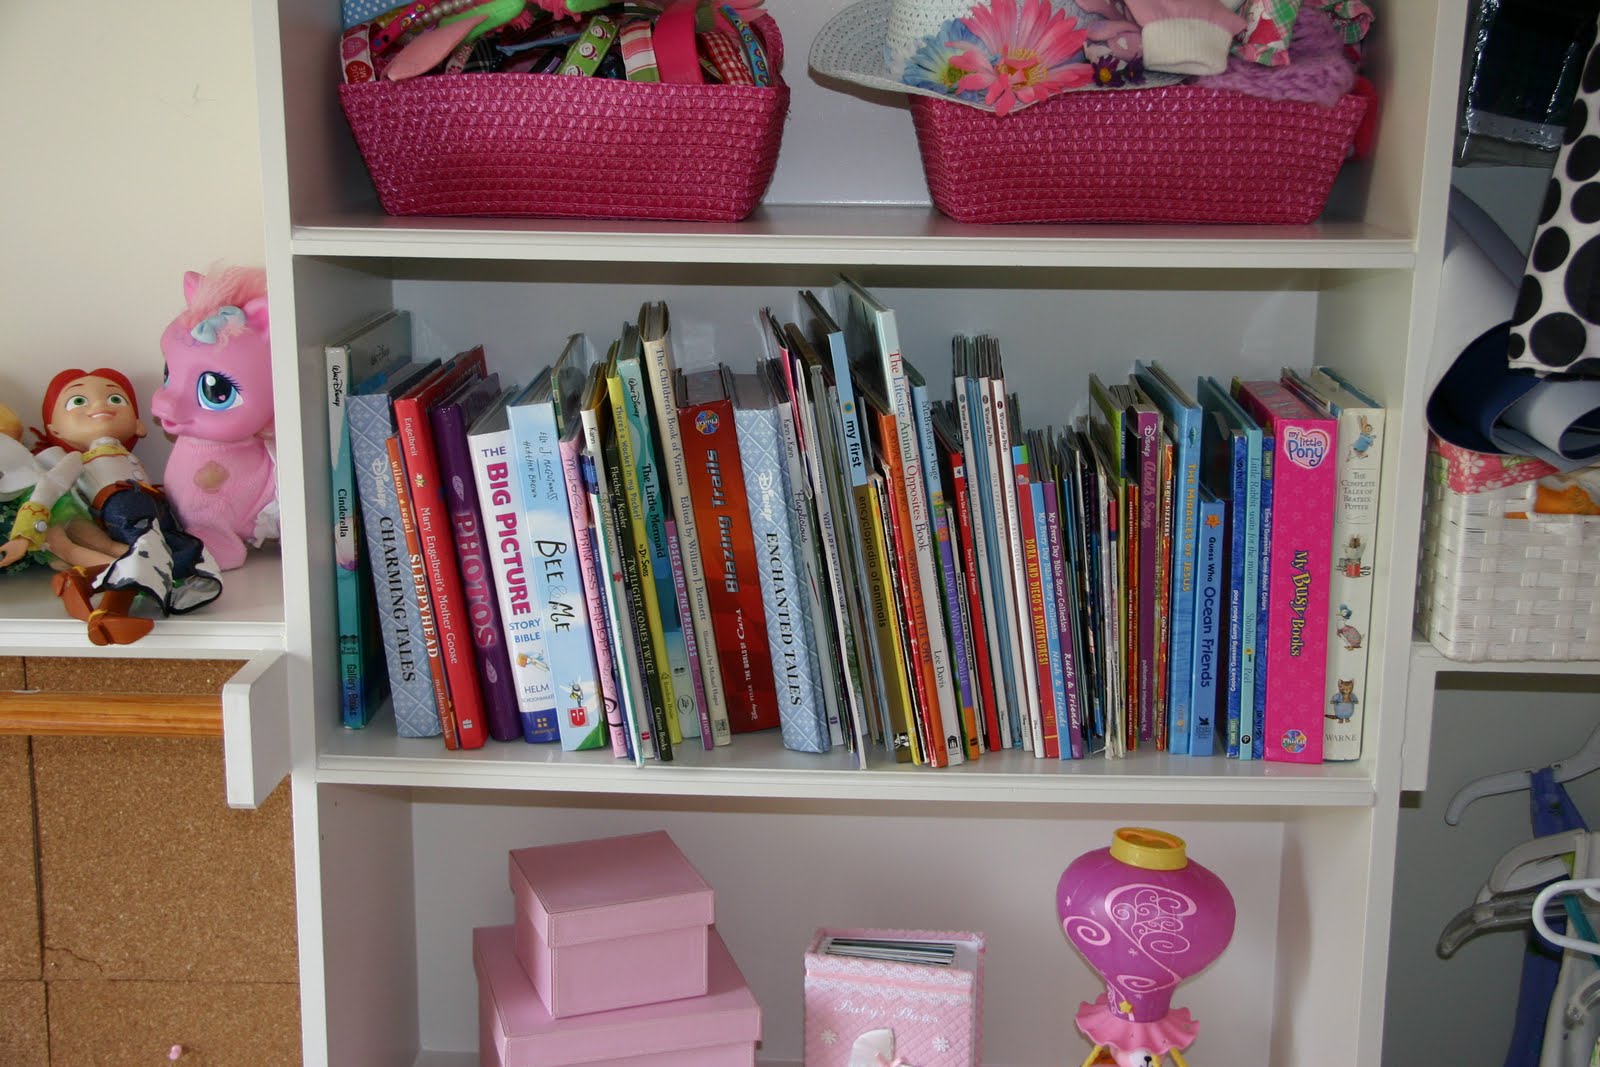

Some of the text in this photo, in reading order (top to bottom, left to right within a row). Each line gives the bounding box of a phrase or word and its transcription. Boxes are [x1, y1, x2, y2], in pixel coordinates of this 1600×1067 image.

[358, 66, 368, 79] ME
[890, 348, 902, 373] The
[331, 380, 346, 406] Disney
[893, 376, 906, 418] Lifesize
[656, 349, 684, 486] The Children's Book of Virtues
[922, 400, 934, 450] McBratney
[404, 418, 418, 456] Engelbreit
[482, 446, 507, 458] THE
[846, 420, 862, 468] my first
[900, 422, 912, 462] Animal
[1141, 424, 1156, 457] Disney
[1288, 431, 1322, 448] my little
[1288, 440, 1324, 466] Pony
[372, 456, 390, 507] Disney
[1250, 458, 1260, 479] Little
[392, 460, 414, 533] wilson segal
[758, 470, 774, 522] Disney
[906, 464, 922, 520] Opposites
[1250, 480, 1259, 506] Rabbit
[338, 488, 348, 538] Cinderella
[642, 464, 666, 558] The Little Mermaid
[680, 496, 691, 526] Edited
[706, 450, 739, 592] Blazing Trails
[1038, 512, 1046, 524] My
[1048, 512, 1056, 523] My
[1182, 464, 1197, 592] THE MIRACLES OF JESUS
[1250, 510, 1258, 530] waits
[486, 462, 530, 616] BIG PICTURE
[684, 527, 693, 540] by
[916, 522, 928, 552] Book
[1040, 525, 1048, 546] Every
[1050, 524, 1058, 544] Every
[1248, 532, 1258, 544] for
[534, 540, 568, 583] BEE
[687, 540, 698, 576] William
[858, 496, 886, 628] encyclopedia of animals
[1052, 545, 1060, 558] Day
[1248, 546, 1256, 558] the
[421, 507, 458, 664] Mary Engelbreit's Mother Goose
[456, 512, 498, 648] PHOTOS
[578, 528, 597, 590] PRINCESS
[590, 596, 609, 657] PENELOPE
[626, 556, 643, 606] TWILIGHT
[669, 536, 698, 657] MOSES AND THE PRINCESS
[1044, 582, 1053, 601] Story
[1055, 578, 1063, 596] Story
[380, 516, 416, 682] CHARMING TALES
[410, 554, 438, 658] SLEEPYHEAD
[695, 586, 706, 620] Bennett
[1025, 538, 1048, 665] DORA AND DIEGO'S ADVENTURES!
[1058, 597, 1066, 632] Collection
[1201, 537, 1216, 688] Guess Who Ocean Friends
[1290, 550, 1312, 656] My Busy Books
[509, 618, 541, 630] STORY
[548, 601, 575, 632] ME
[636, 609, 650, 642] COMES
[737, 609, 746, 640] Cars
[766, 532, 802, 706] ENCHANTED TALES
[915, 604, 926, 638] LITTLE
[1046, 602, 1057, 640] Collection
[514, 632, 542, 644] BIBLE
[642, 644, 654, 675] TWICE
[936, 664, 944, 688] Davis
[346, 664, 356, 693] Gallery
[524, 684, 550, 694] HELM
[1064, 652, 1074, 678] Ruth
[1069, 694, 1078, 730] Friends
[1325, 732, 1358, 742] WARNE
[834, 999, 939, 1024] Baby's Photos
